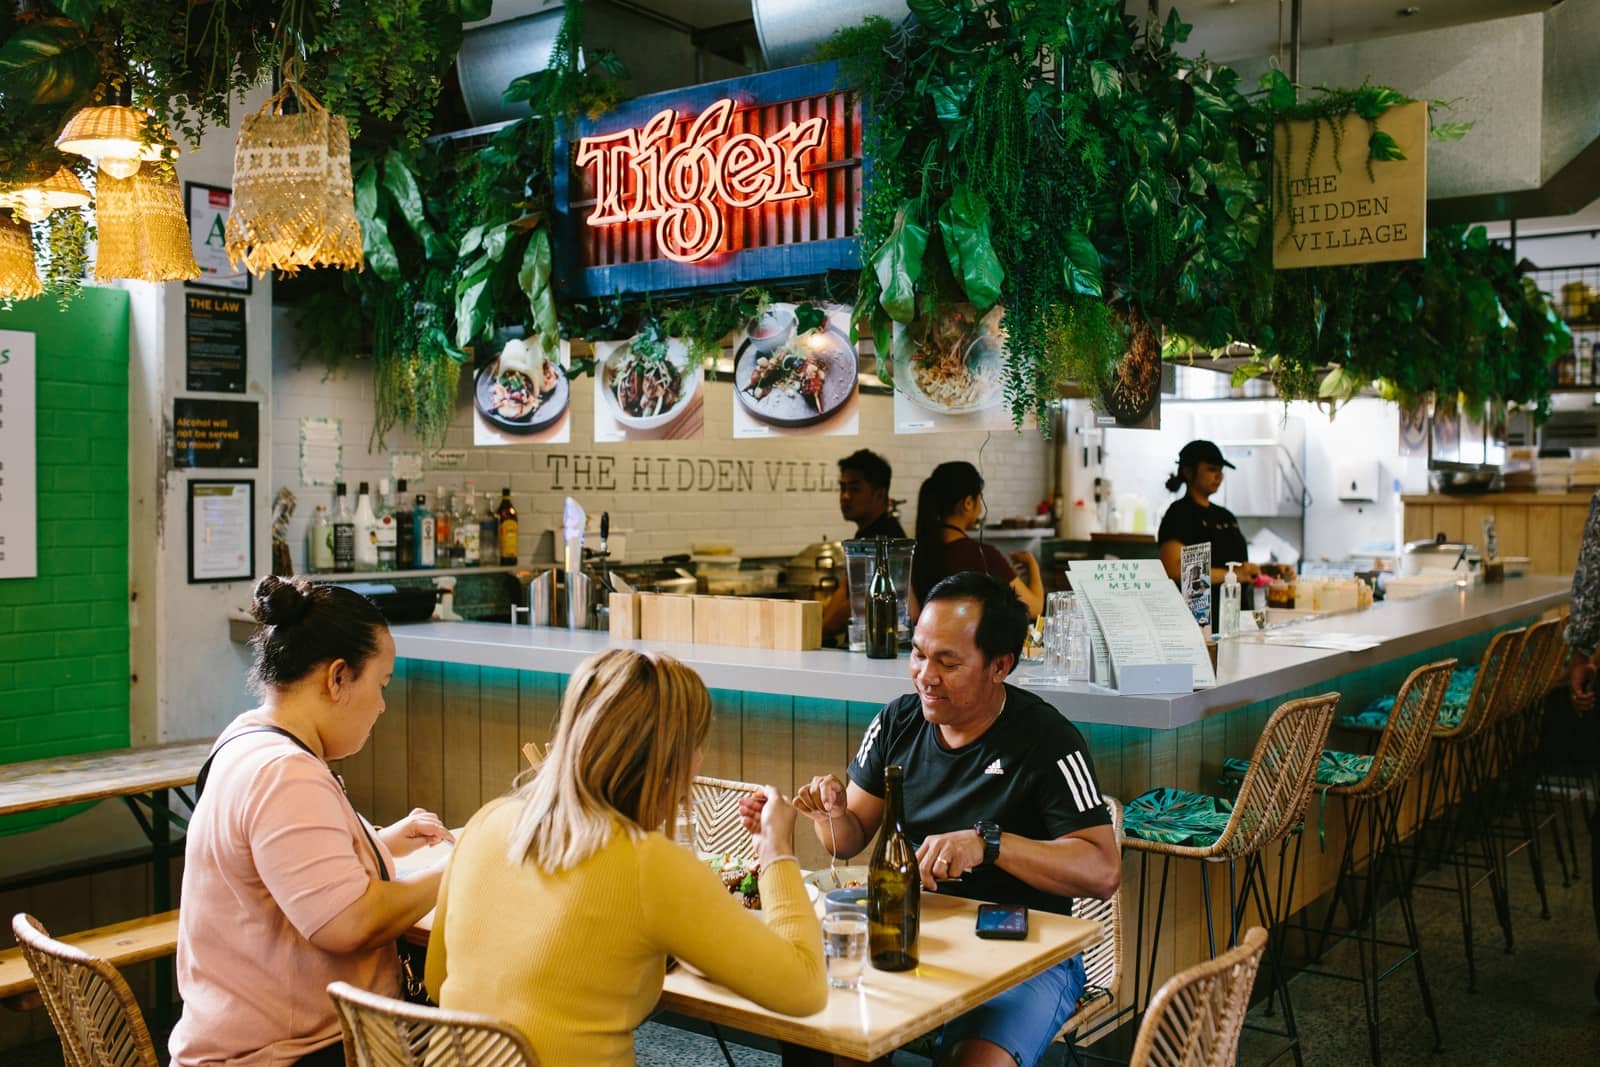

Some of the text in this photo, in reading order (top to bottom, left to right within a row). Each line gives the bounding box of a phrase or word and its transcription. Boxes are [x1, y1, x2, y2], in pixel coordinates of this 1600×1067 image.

[576, 98, 828, 263] Tiger
[1290, 175, 1337, 198] THE
[1291, 196, 1389, 225] HIDDEN
[204, 212, 226, 248] A
[1292, 223, 1408, 251] VILLAGE
[190, 298, 240, 313] THE LAW
[547, 454, 840, 493] THE HIDDEN VILL
